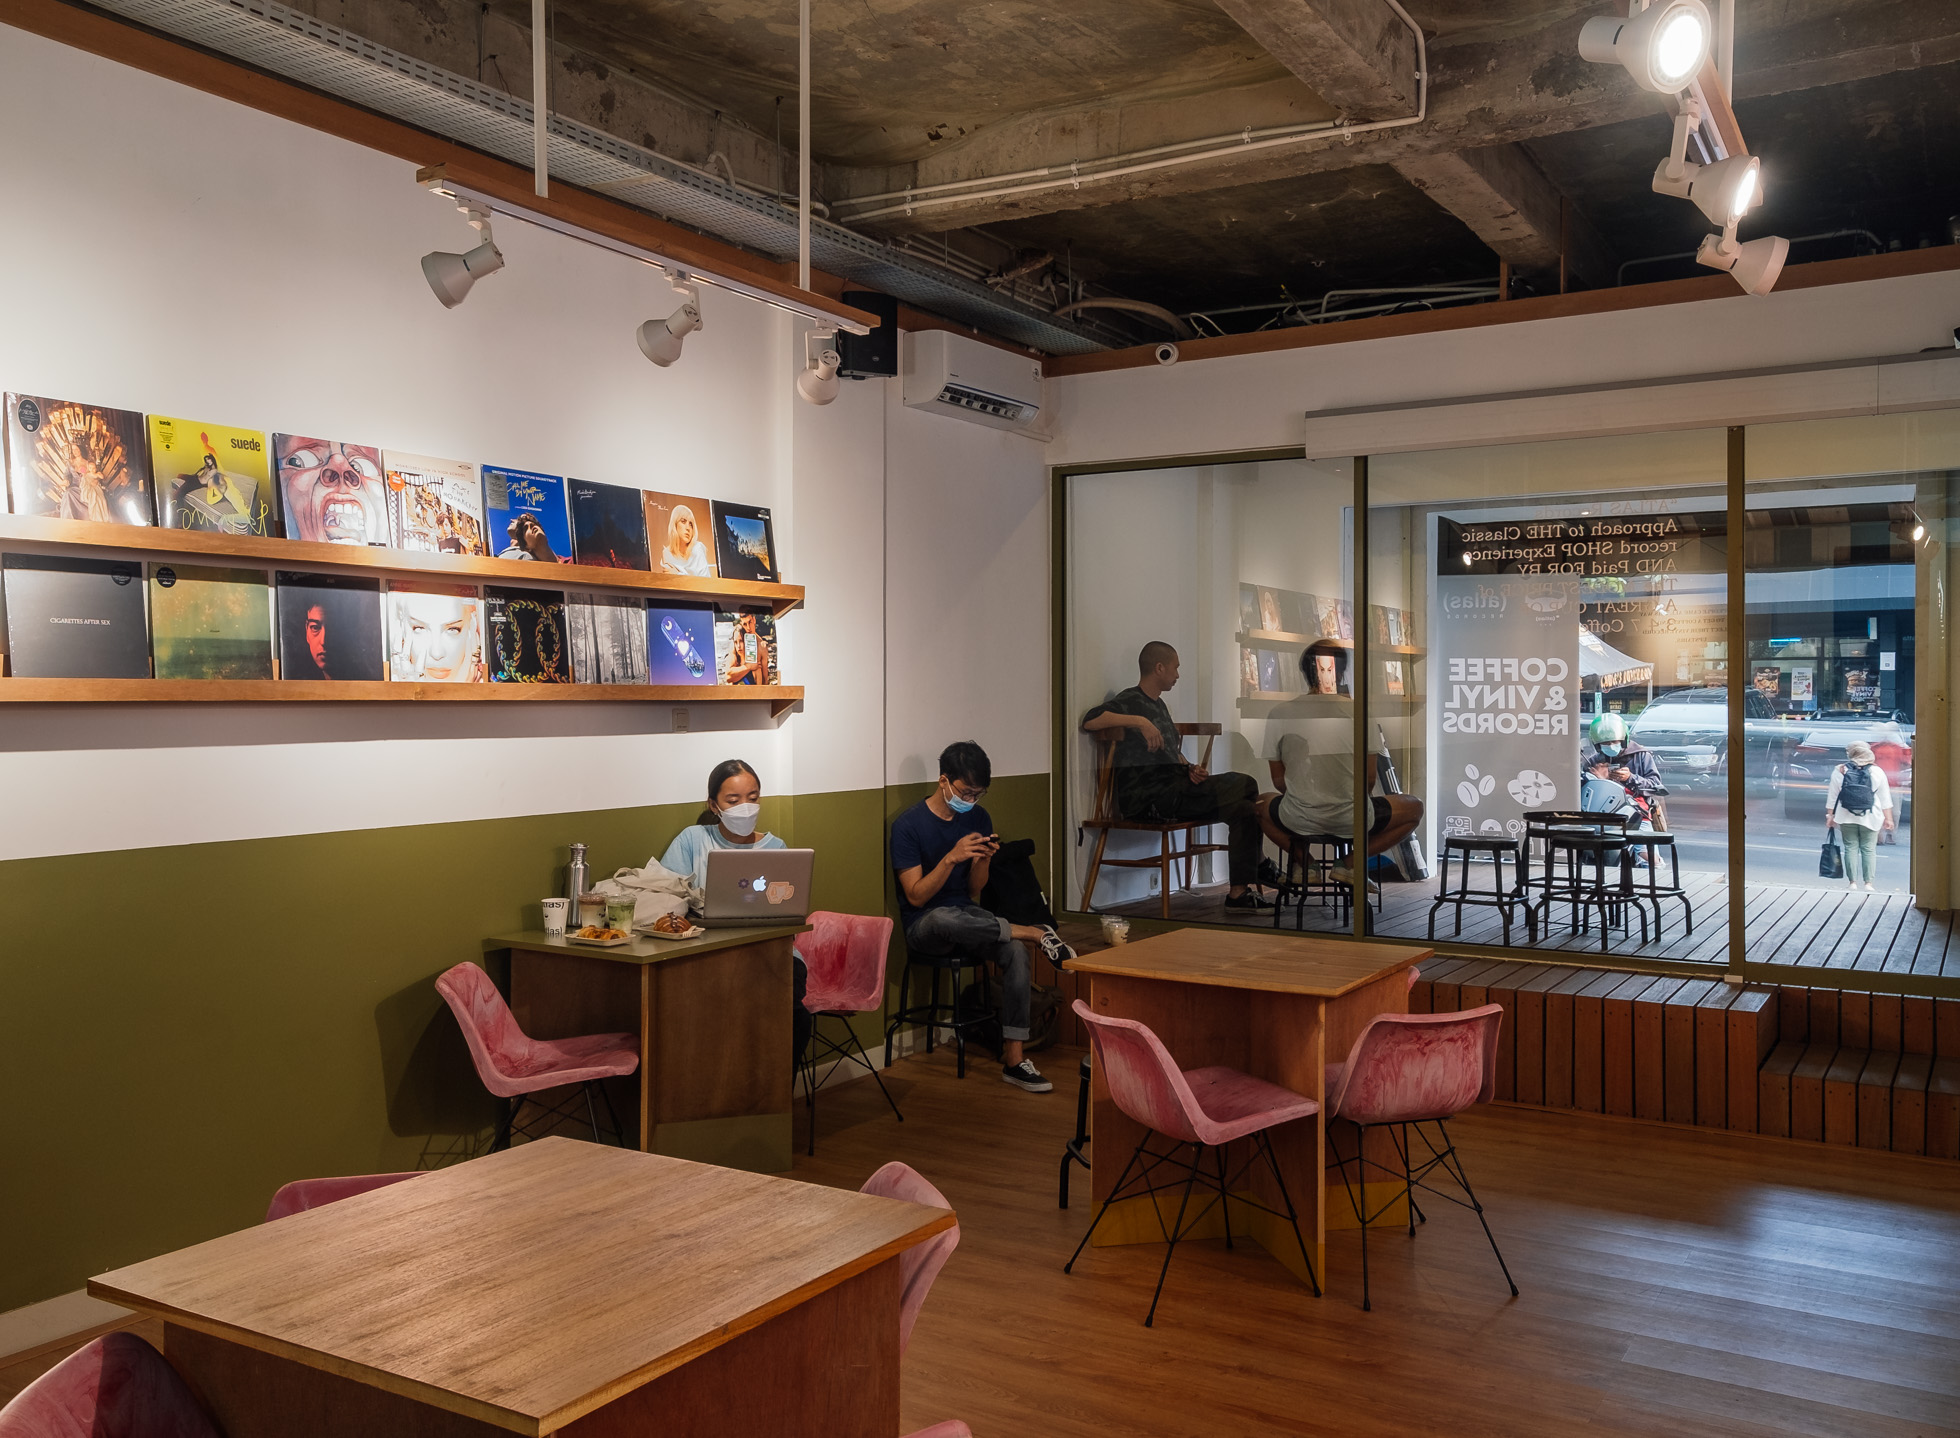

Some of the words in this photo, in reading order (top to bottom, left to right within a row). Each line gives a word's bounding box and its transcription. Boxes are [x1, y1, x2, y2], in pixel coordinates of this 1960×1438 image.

[230, 438, 261, 452] suede
[506, 482, 520, 493] CALL
[527, 491, 547, 506] NAME
[49, 617, 84, 625] CIGARETTES
[83, 618, 101, 626] AFTER
